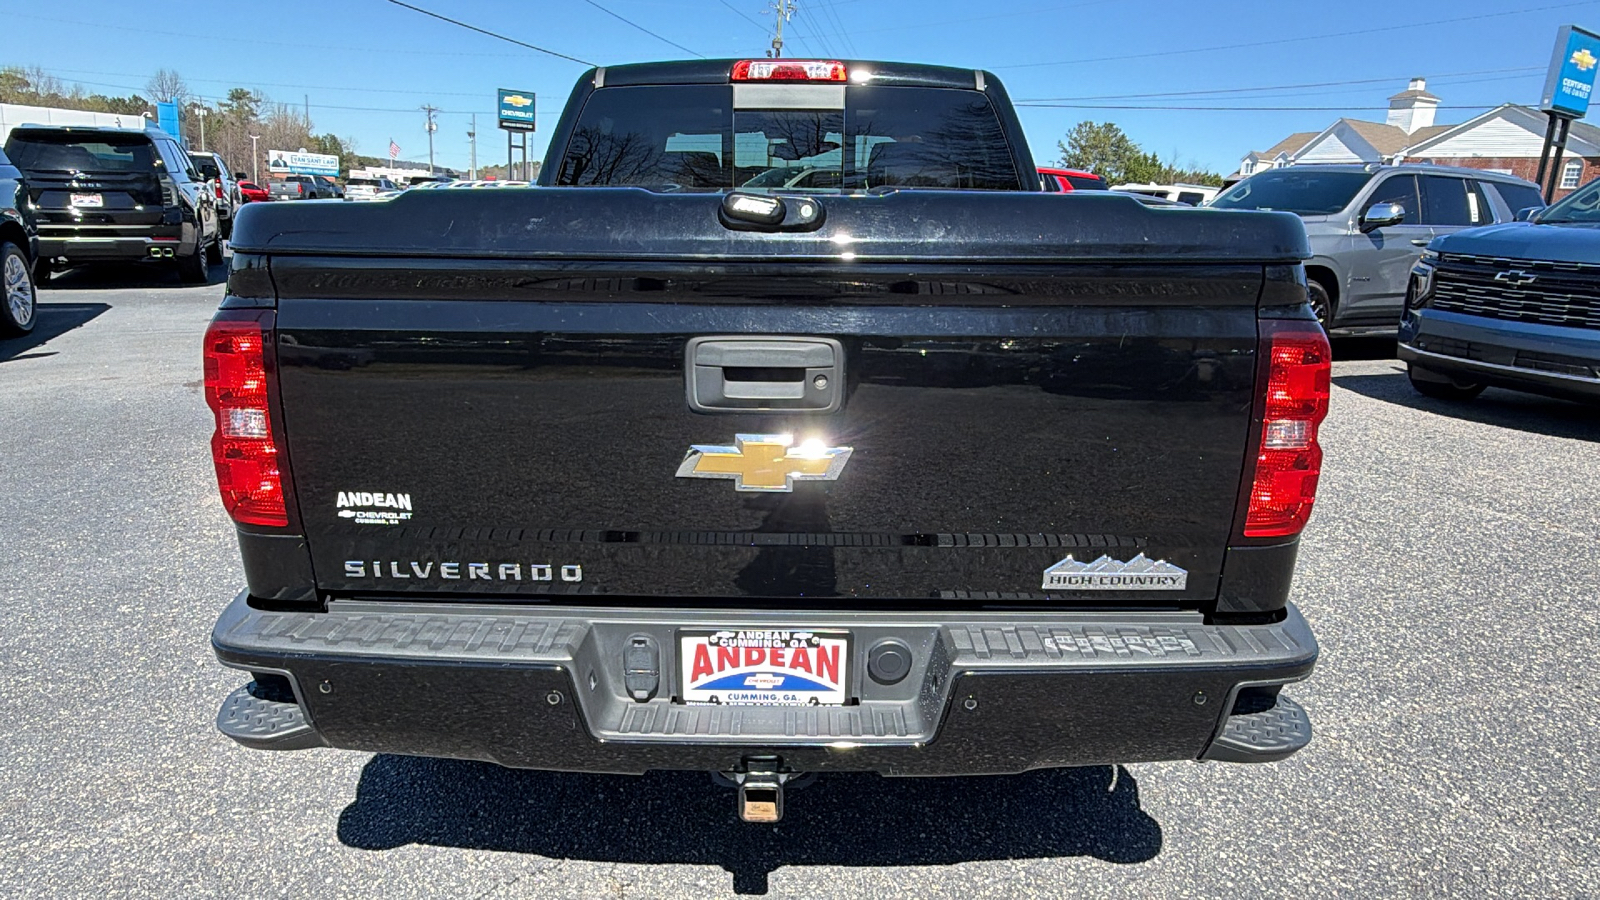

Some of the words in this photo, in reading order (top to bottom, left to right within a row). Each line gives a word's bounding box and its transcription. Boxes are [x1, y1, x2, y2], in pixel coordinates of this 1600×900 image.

[1563, 78, 1591, 92] CERTIFIED
[501, 110, 533, 118] CHEVROLET
[336, 491, 413, 511] ANDEAN
[356, 511, 413, 520] CHEVROLET
[344, 560, 584, 583] SILVERADO
[1049, 575, 1093, 585] HIGH
[1099, 576, 1181, 586] COUNTRY
[737, 631, 791, 641] ANDEAN
[719, 639, 786, 649] CUMMING,
[789, 639, 808, 648] GA
[690, 643, 840, 686] ANDEAN
[727, 693, 780, 702] CUMMING,
